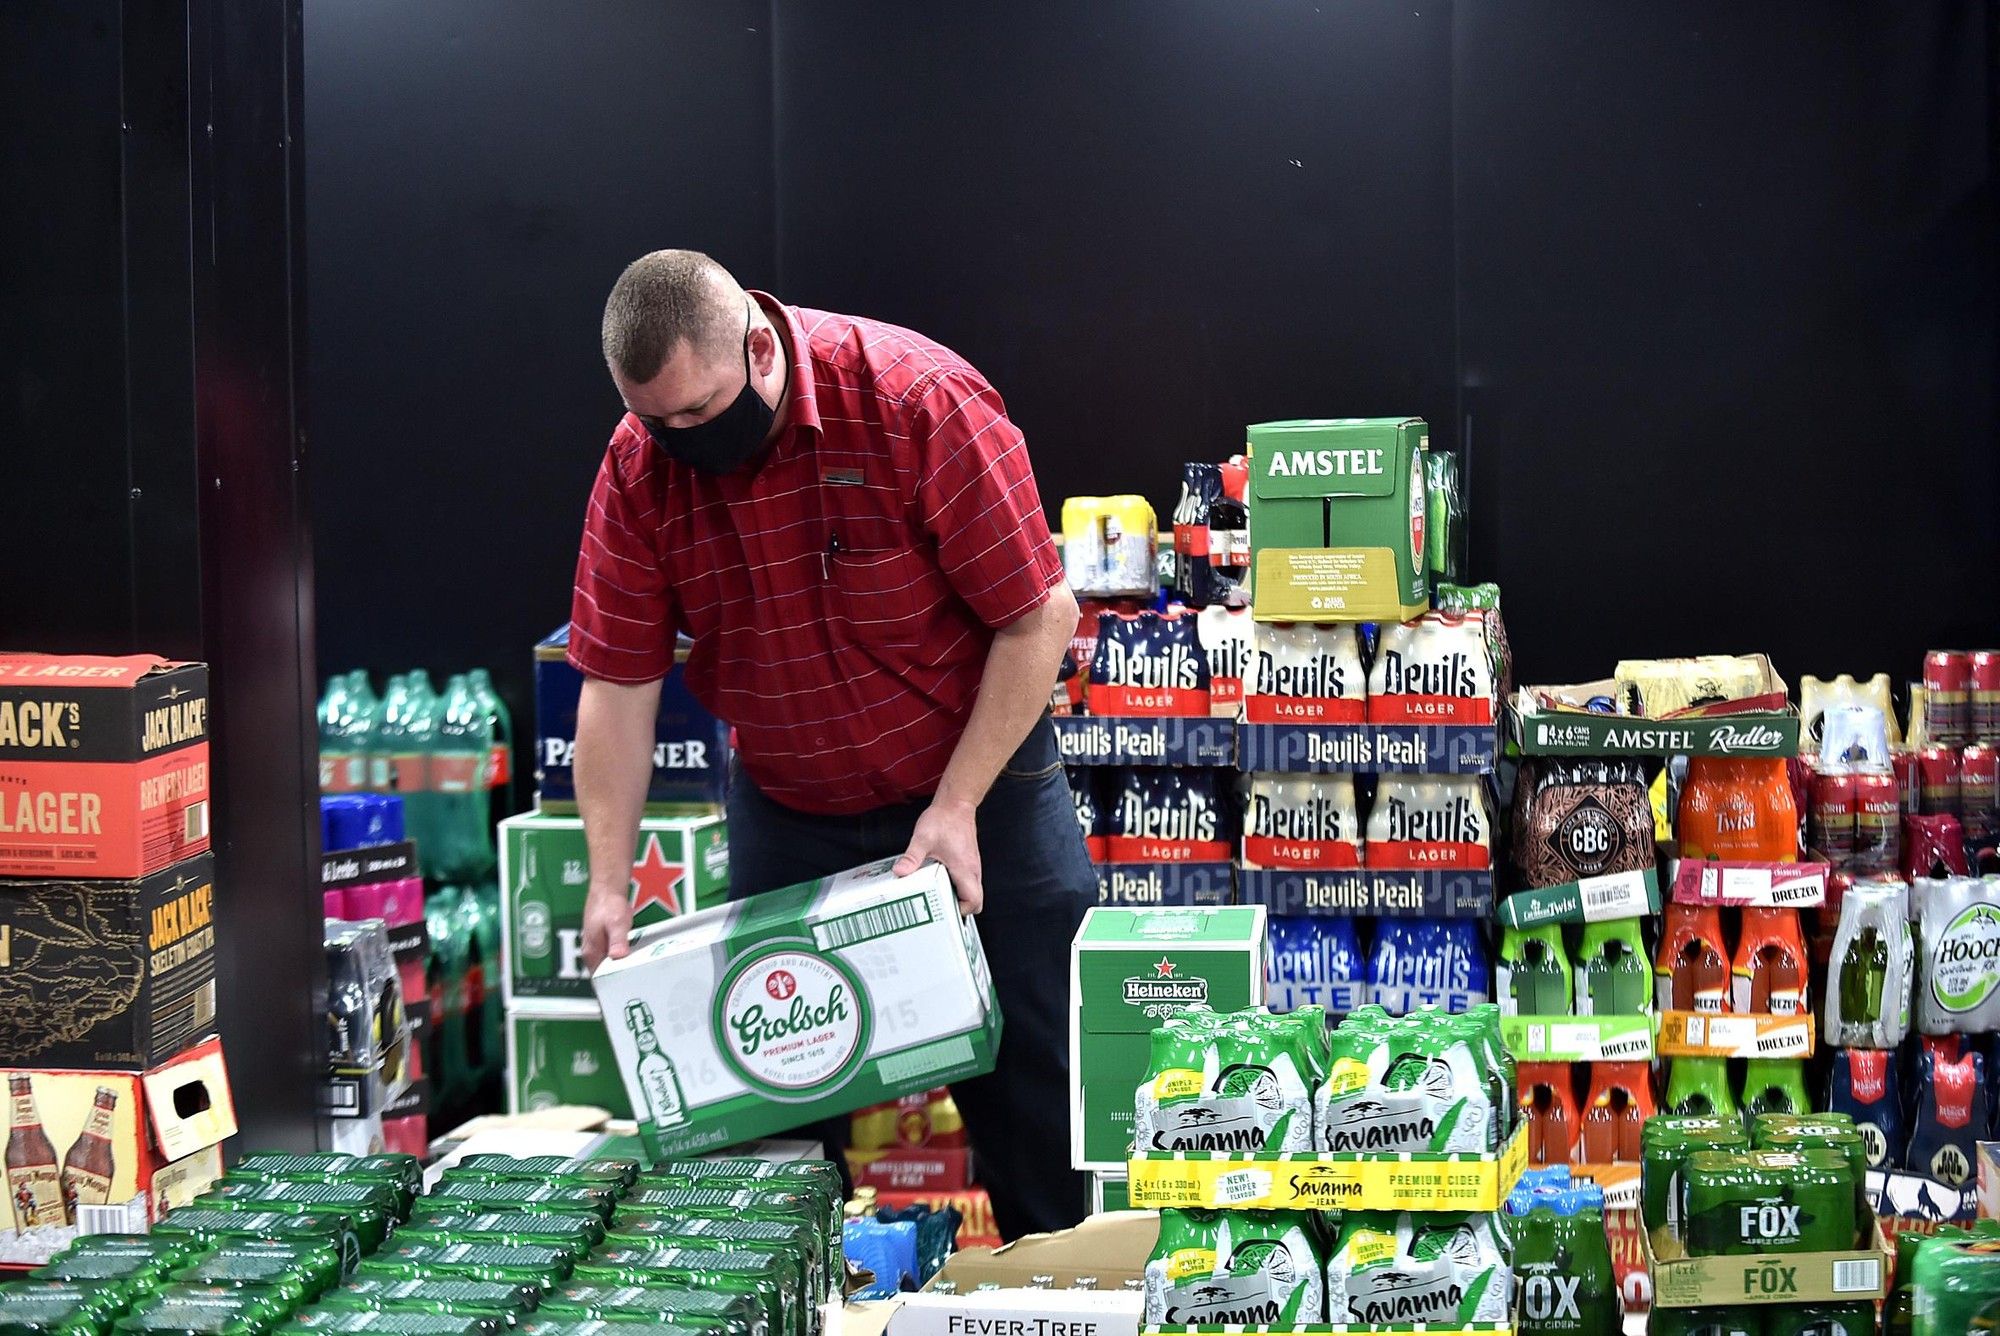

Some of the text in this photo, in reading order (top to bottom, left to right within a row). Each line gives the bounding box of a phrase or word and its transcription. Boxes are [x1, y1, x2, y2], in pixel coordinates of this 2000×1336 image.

[1268, 449, 1383, 477] AMSTEL
[14, 665, 129, 677] LAGER
[1107, 637, 1199, 690] Devil's
[1257, 649, 1345, 698] Devil's
[1384, 649, 1476, 698] Devil's
[1126, 693, 1174, 708] LAGER
[1275, 702, 1324, 717] LAGER
[1406, 702, 1456, 716] LAGER
[142, 707, 170, 752] JACK
[1115, 725, 1165, 757] Peak
[1549, 724, 1556, 740] 4
[1557, 729, 1564, 740] x
[1566, 725, 1573, 740] 6
[1603, 725, 1784, 753] AMSTEL Radler
[1308, 732, 1427, 765] Devil's Peak
[0, 791, 102, 835] LAGER
[1124, 788, 1217, 842] Devil's
[1252, 794, 1340, 842] Devil's
[1388, 795, 1480, 843] Devil's
[1717, 811, 1757, 833] Twist
[1142, 846, 1191, 860] LAGER
[1273, 844, 1321, 860] LAGER
[1572, 826, 1608, 853] CBC
[1409, 848, 1457, 861] LAGER
[1113, 871, 1162, 902] Peak
[1305, 876, 1424, 909] Devil's Peak
[1772, 886, 1819, 904] BREEZER
[149, 900, 181, 951] JACK
[1127, 982, 1203, 999] Heineken
[731, 984, 848, 1056] Grolsch
[881, 1000, 919, 1033] 15
[763, 1031, 836, 1058] PREMIUM LAGER
[1601, 1039, 1649, 1058] BREEZER
[1226, 1173, 1249, 1185] NEW!
[1226, 1182, 1257, 1193] JUNIPER
[1289, 1174, 1363, 1199] Savanna
[1390, 1175, 1481, 1186] PREMIUM CIDER
[1144, 1192, 1171, 1200] BOTTLES
[1316, 1198, 1337, 1206] JEAN
[1393, 1188, 1479, 1198] JUNIPER FLAVOUR
[1740, 1205, 1801, 1238] FOX
[1744, 1267, 1797, 1294] FOX
[1348, 1283, 1464, 1325] Savanna
[948, 1315, 1098, 1336] FEVER-TREE
[1545, 1319, 1576, 1330] CIDER
